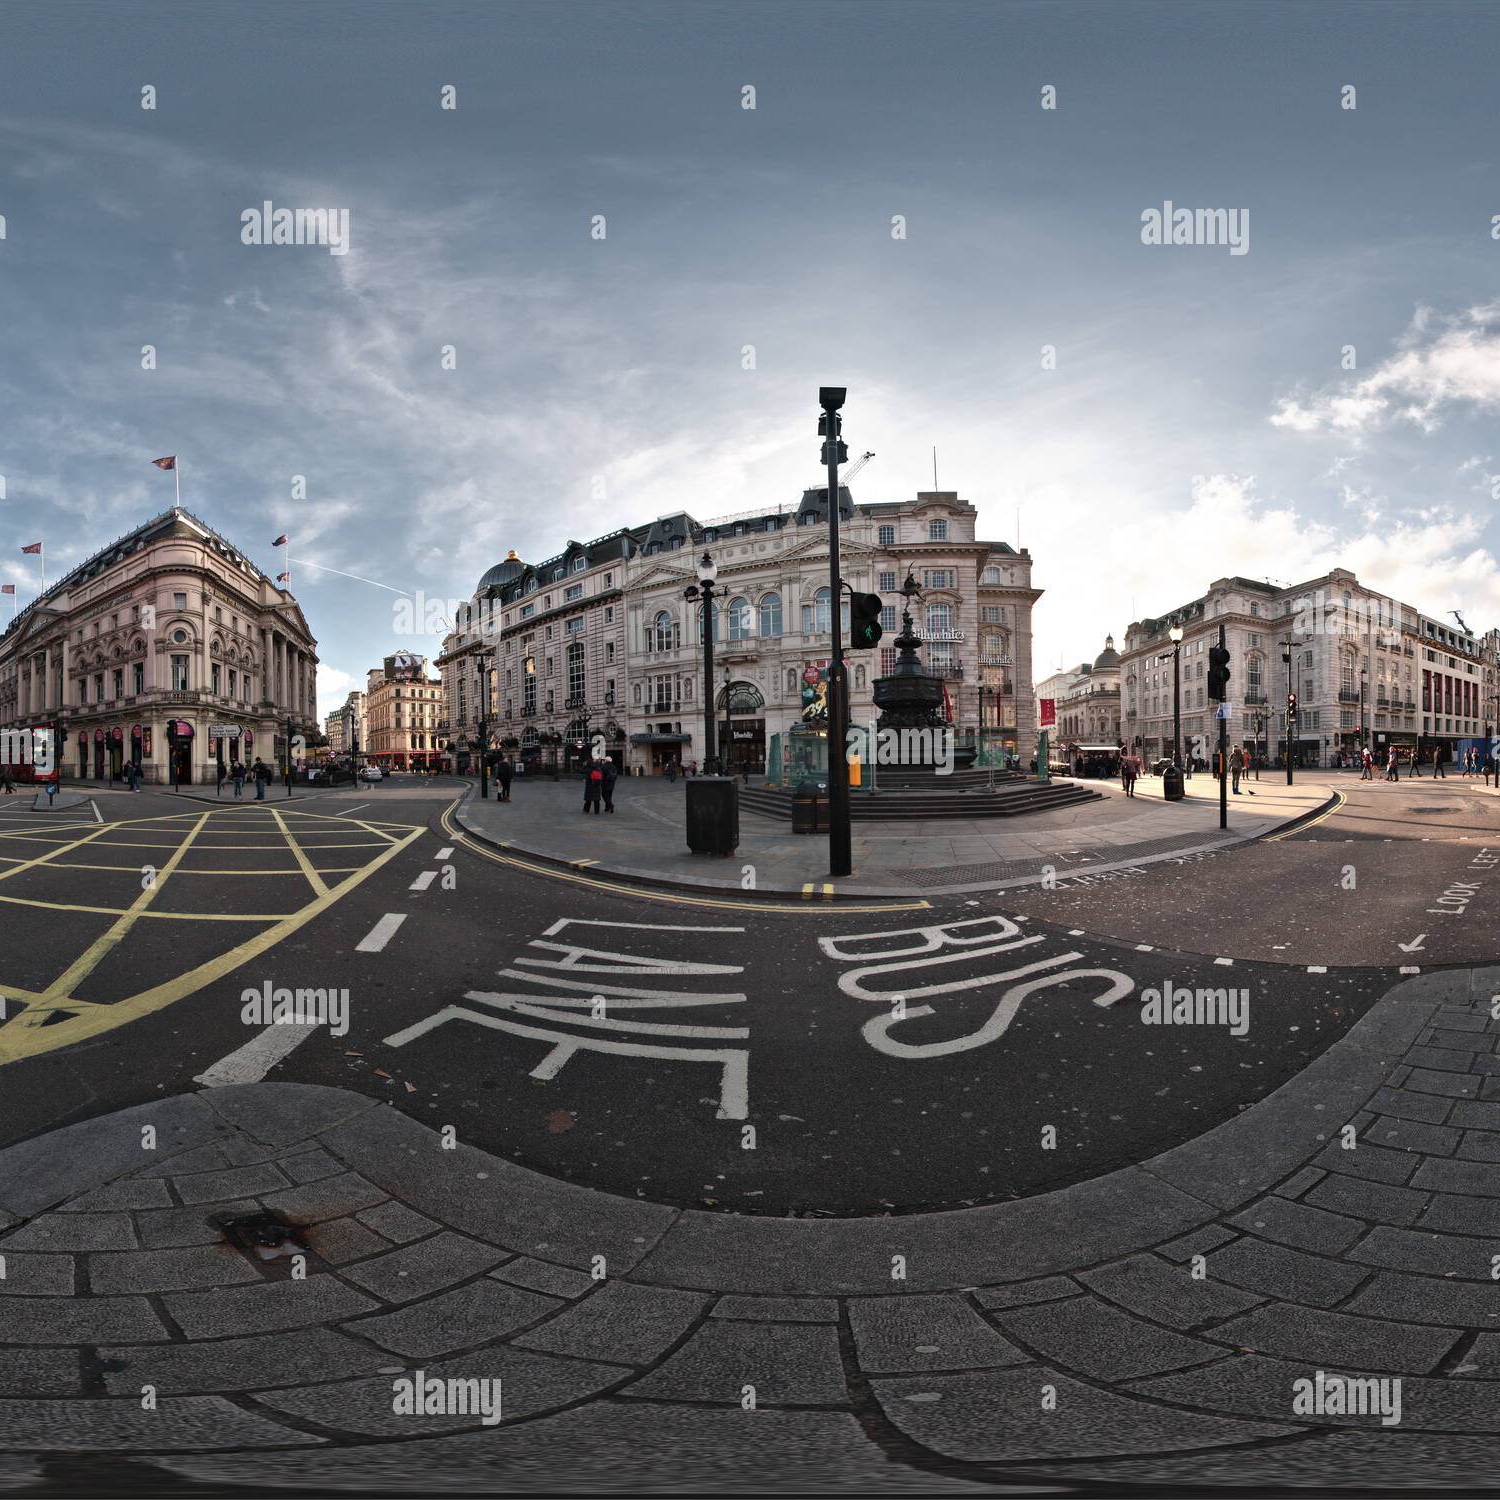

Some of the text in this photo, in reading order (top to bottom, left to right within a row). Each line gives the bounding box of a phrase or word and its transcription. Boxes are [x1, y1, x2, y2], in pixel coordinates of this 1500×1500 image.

[1426, 848, 1500, 914] LOOK LEFT
[382, 918, 750, 1119] LANE
[818, 915, 1136, 1058] BUS
